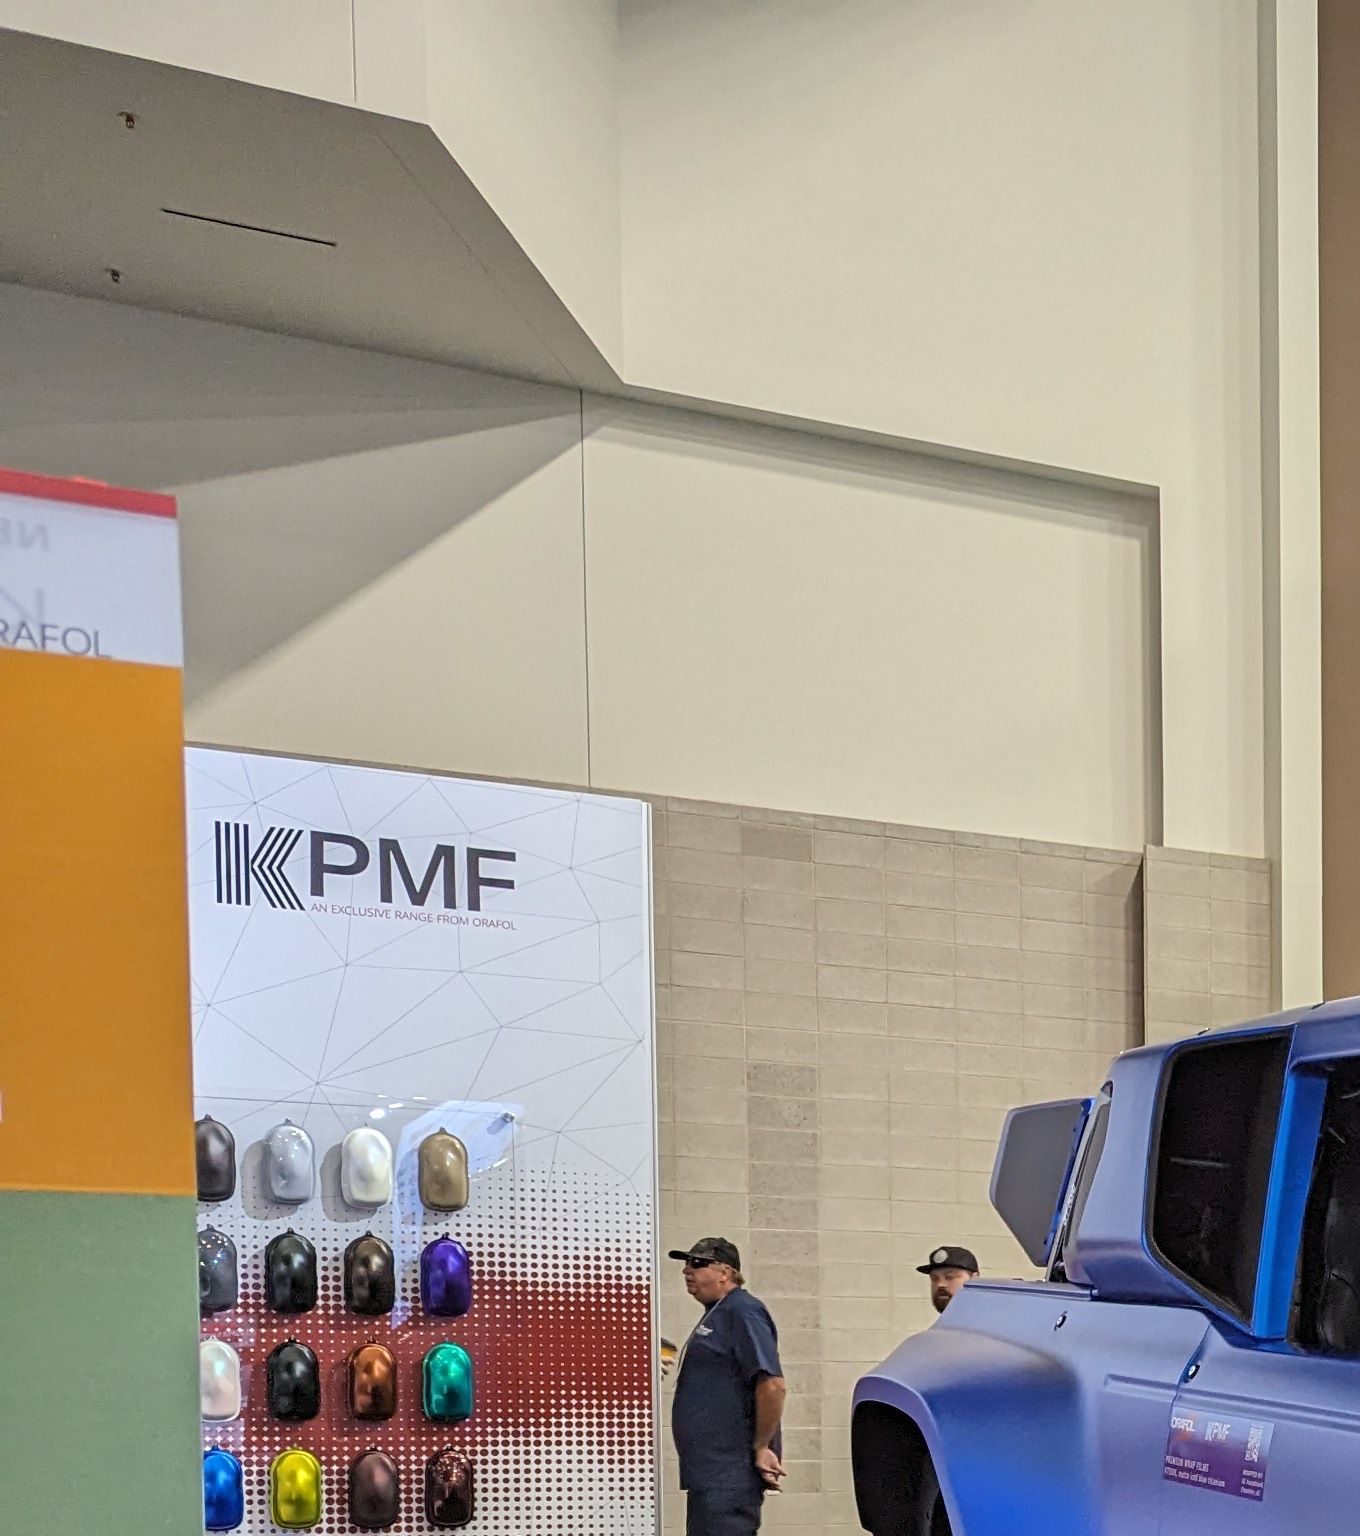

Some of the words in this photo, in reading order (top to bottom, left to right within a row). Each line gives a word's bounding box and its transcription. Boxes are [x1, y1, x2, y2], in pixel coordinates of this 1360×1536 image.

[214, 820, 517, 912] KPMF
[310, 902, 328, 913] AN
[331, 904, 392, 920] EXCLUSIVE
[394, 910, 434, 923] RANGE
[436, 914, 469, 926] FROM
[472, 917, 517, 931] ORAFOL
